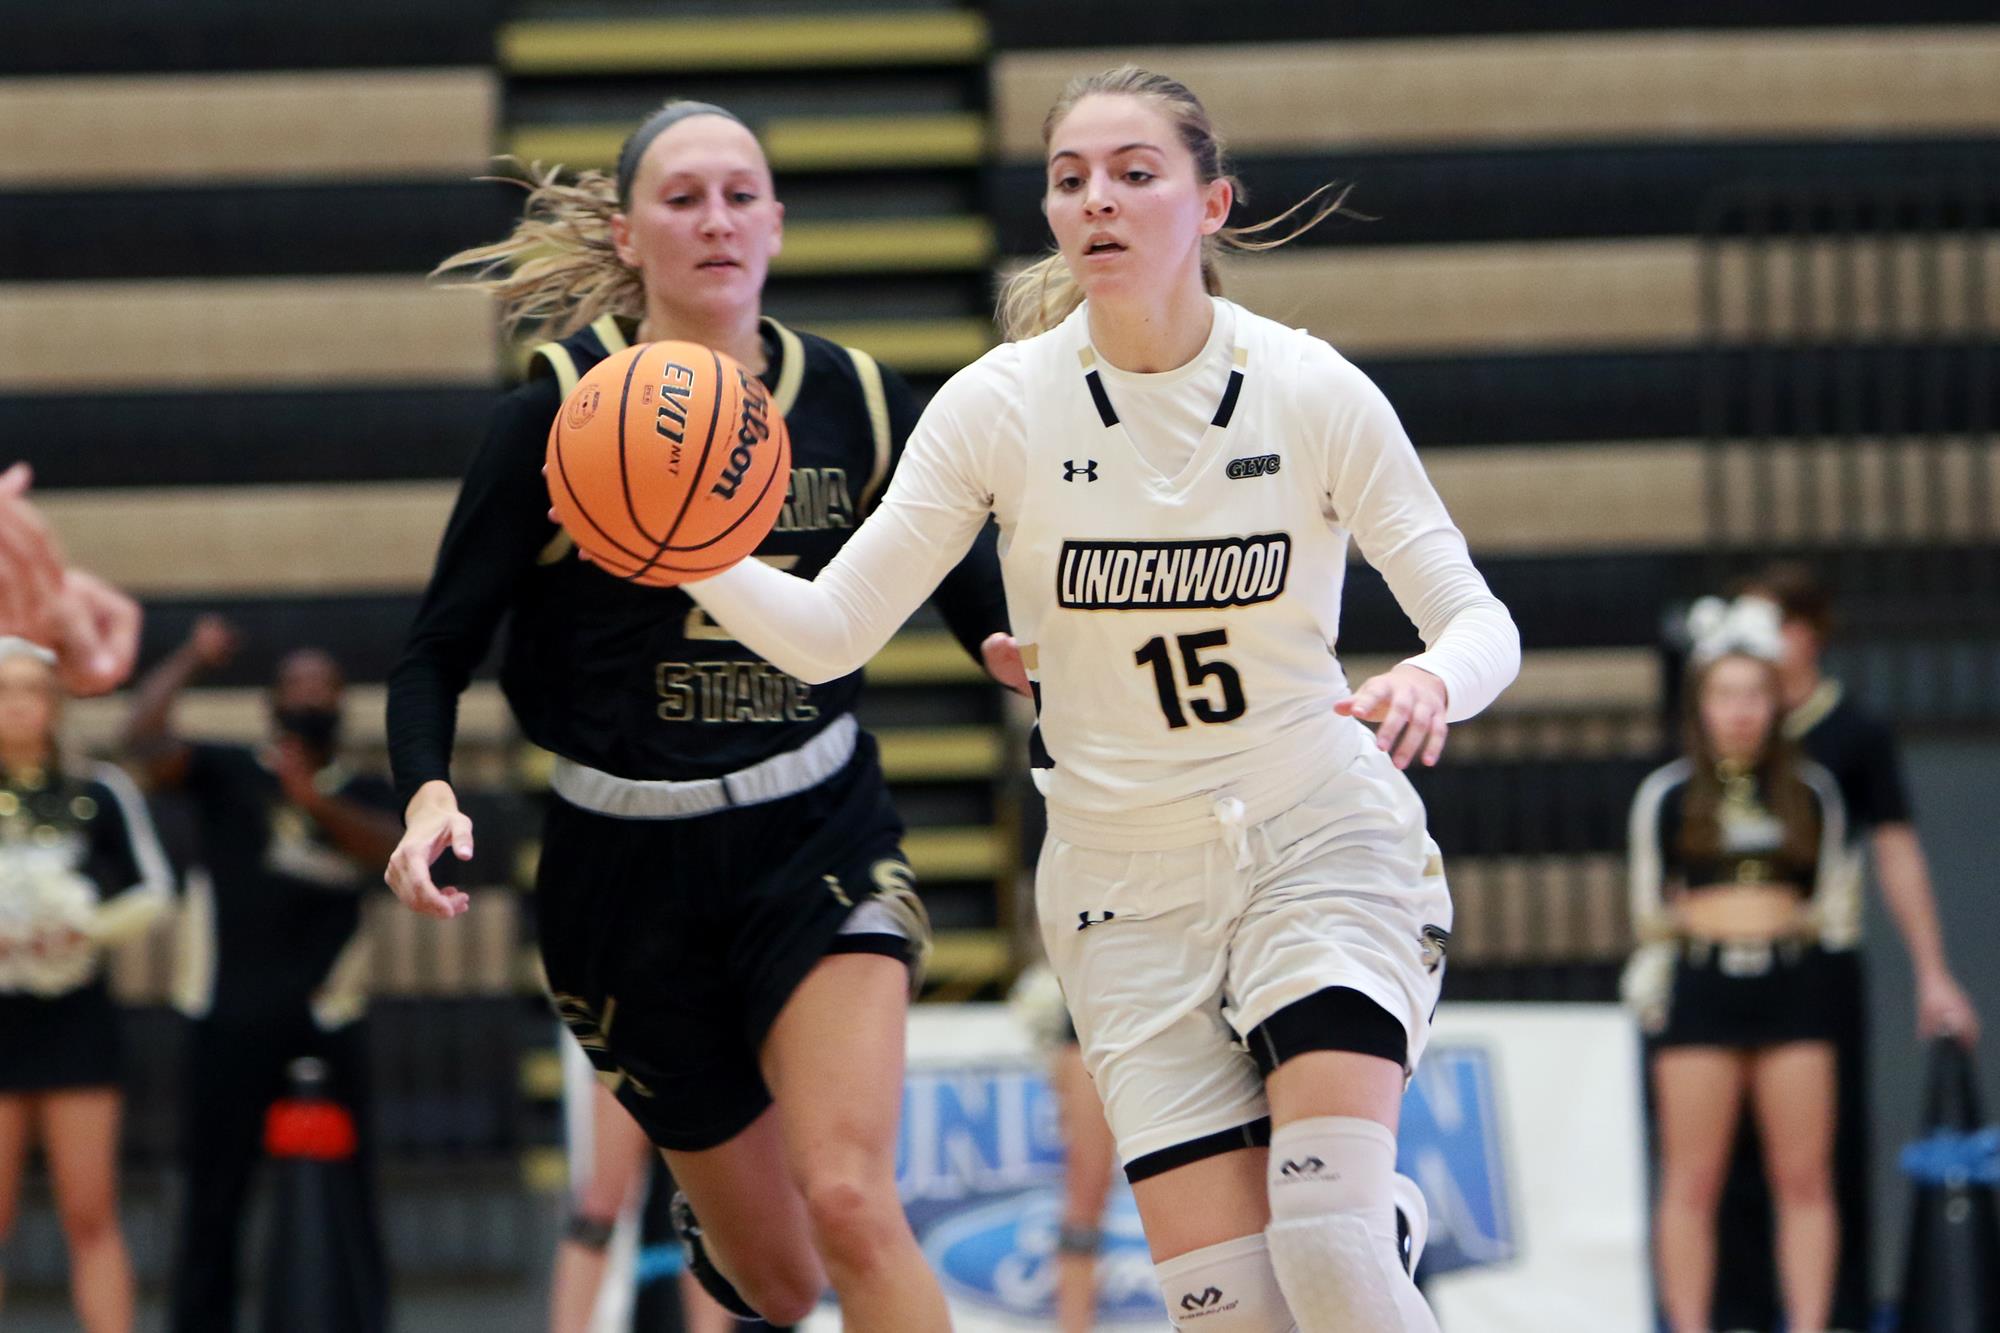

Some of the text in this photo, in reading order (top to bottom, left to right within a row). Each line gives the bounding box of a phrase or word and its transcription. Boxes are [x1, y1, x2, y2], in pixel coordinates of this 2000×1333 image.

[655, 361, 694, 476] EVO NXT
[710, 367, 769, 500] Wilson
[1226, 454, 1280, 479] GLVC
[1060, 539, 1288, 604] LINDENWOOD
[1134, 628, 1247, 729] 15
